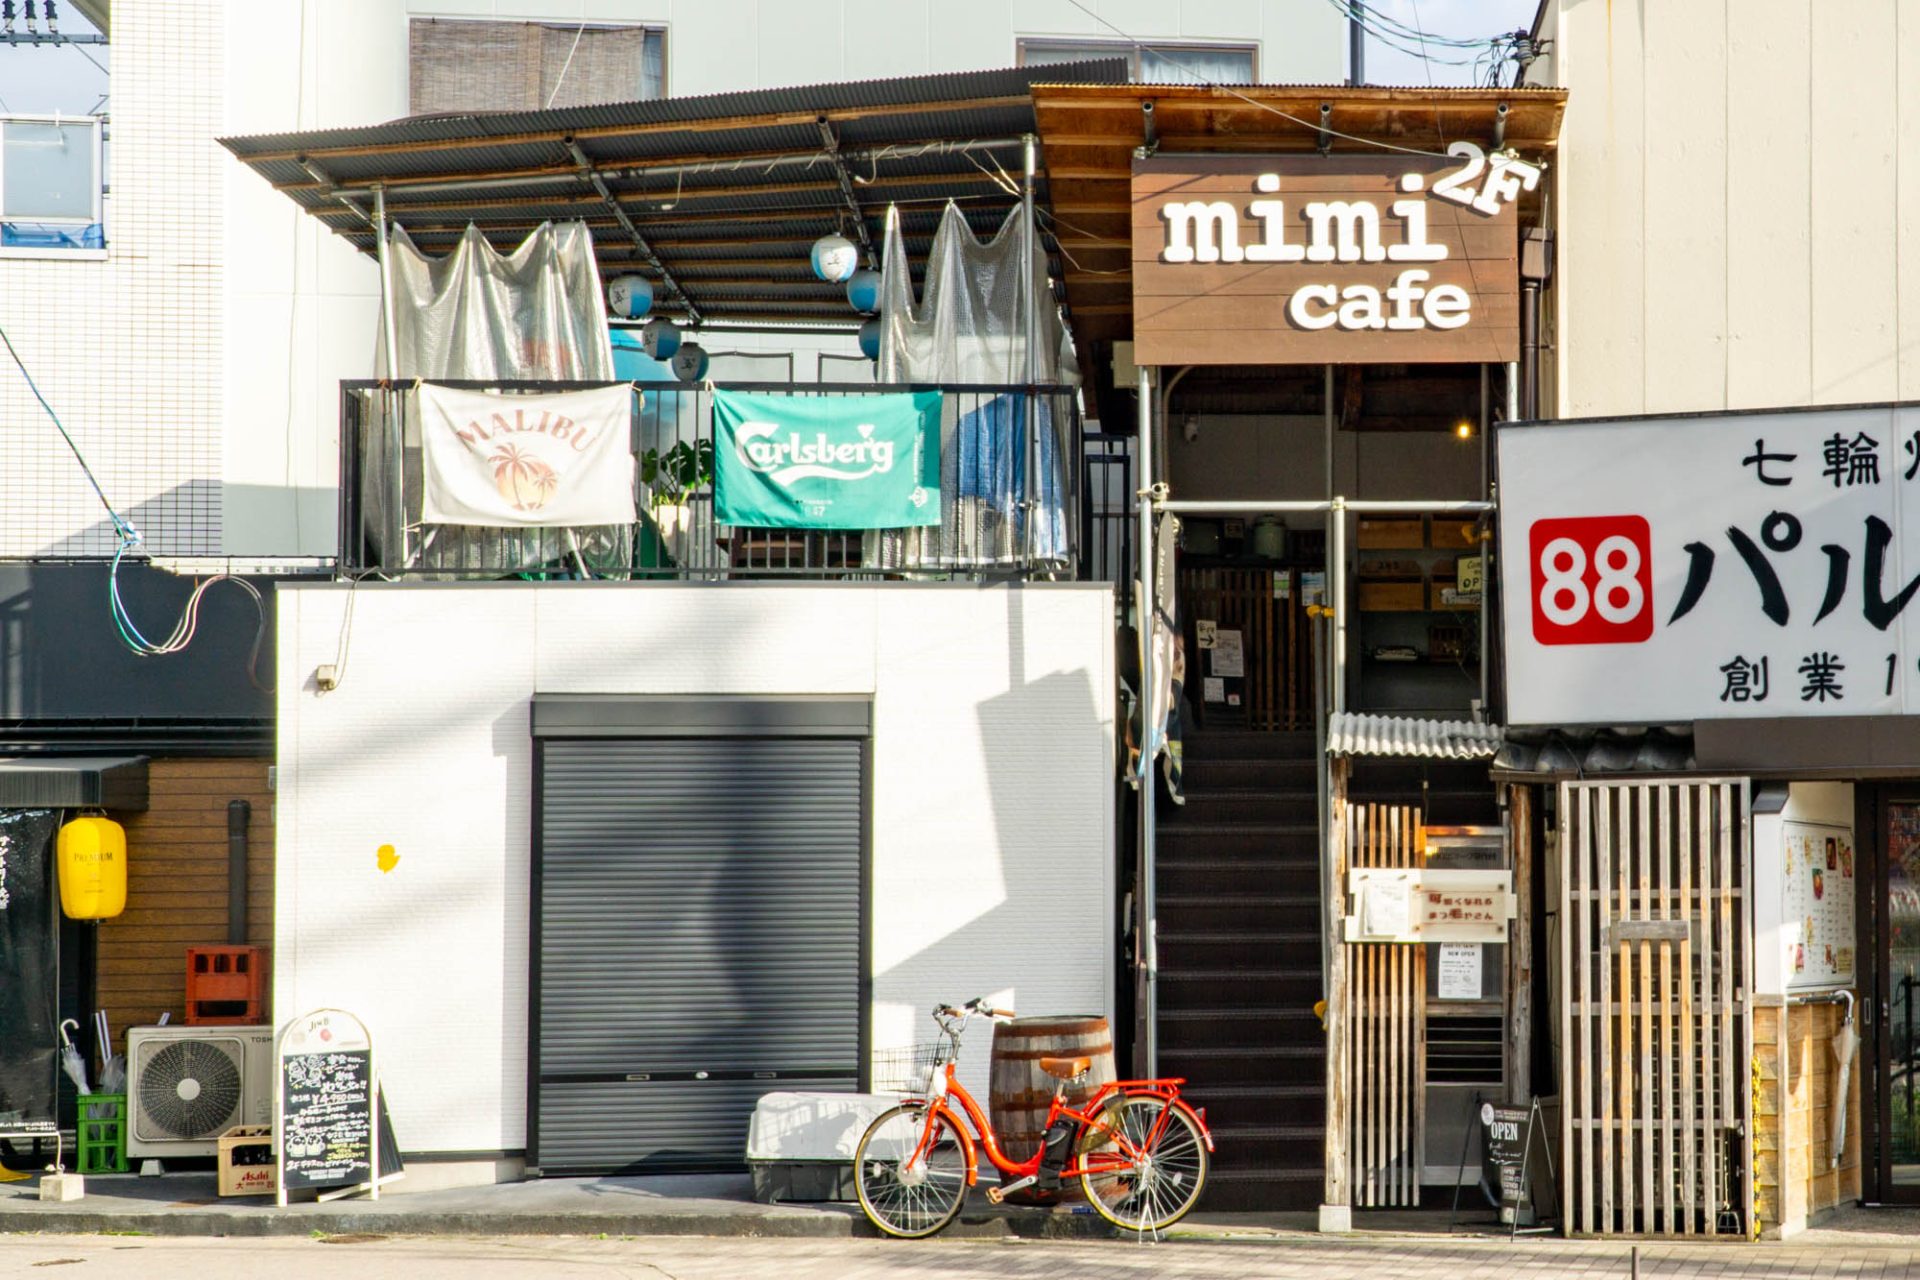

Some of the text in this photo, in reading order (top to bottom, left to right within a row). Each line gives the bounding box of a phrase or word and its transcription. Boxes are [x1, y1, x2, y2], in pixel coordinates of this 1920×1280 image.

[1432, 141, 1540, 215] 2F
[1163, 174, 1449, 262] mimi
[1289, 270, 1471, 330] cafe
[456, 409, 595, 453] MALIBU
[734, 421, 894, 473] Carlsberg
[1540, 535, 1644, 626] 88
[1719, 651, 1920, 702] 創業1
[1491, 1121, 1518, 1141] OPEN
[242, 1171, 269, 1181] Asahi
